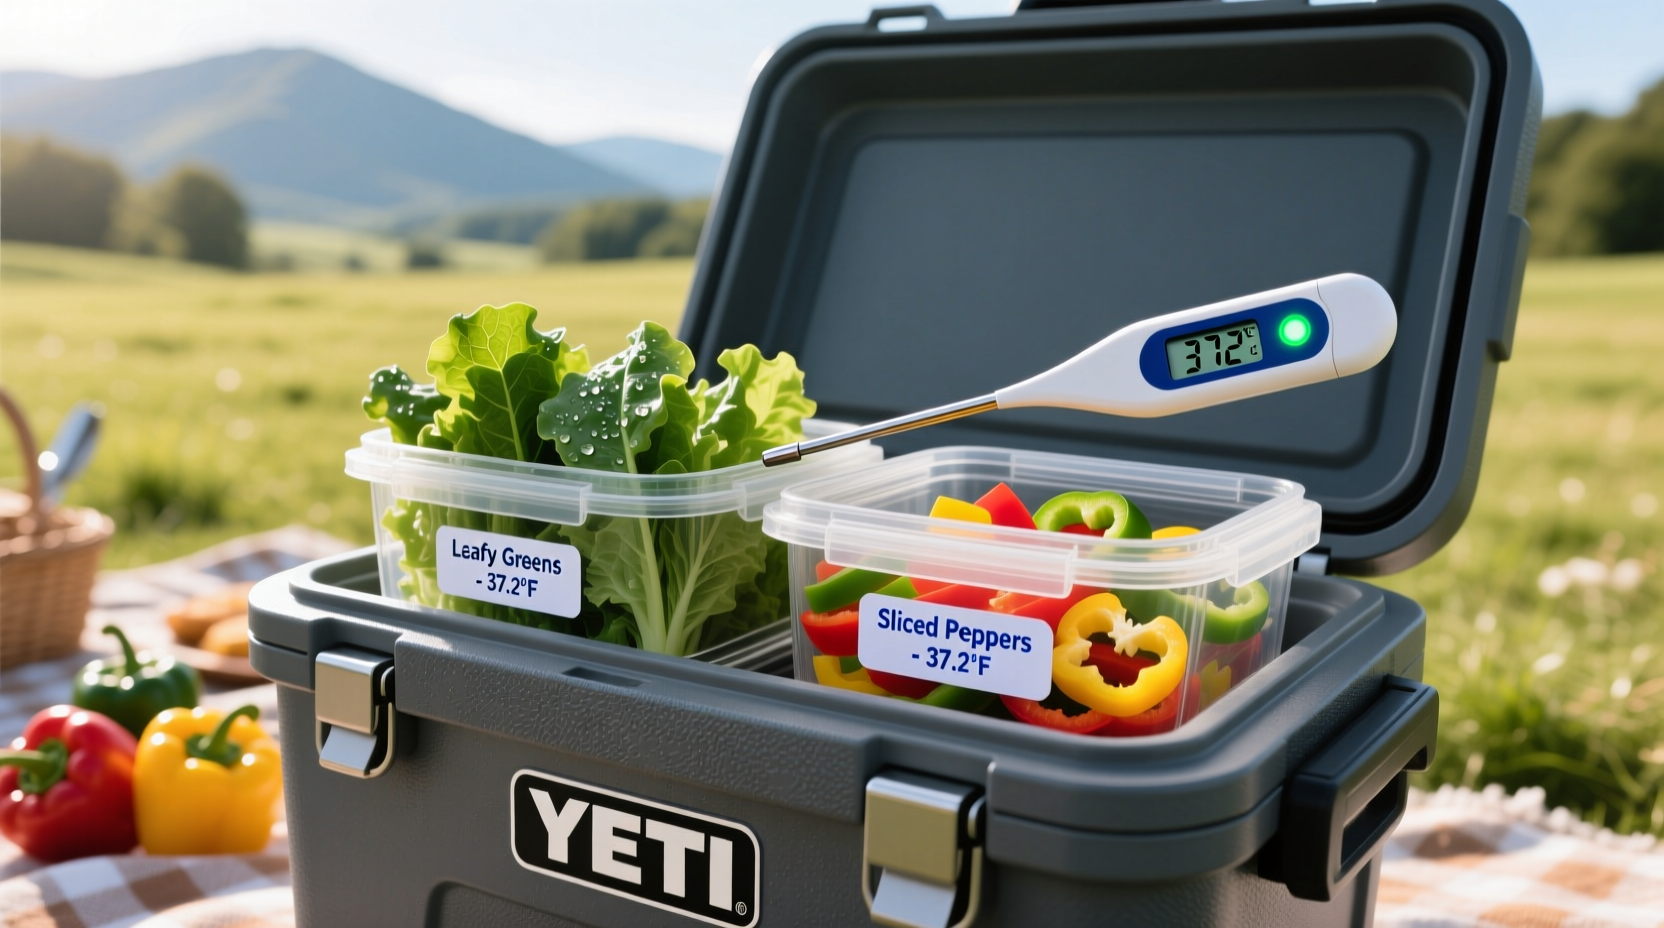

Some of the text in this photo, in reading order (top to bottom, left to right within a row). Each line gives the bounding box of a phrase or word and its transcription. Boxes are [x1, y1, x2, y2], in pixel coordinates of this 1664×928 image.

[452, 538, 562, 575] Leafy Greens
[877, 608, 1032, 653] Sliced Peppers
[528, 787, 733, 912] YETI
